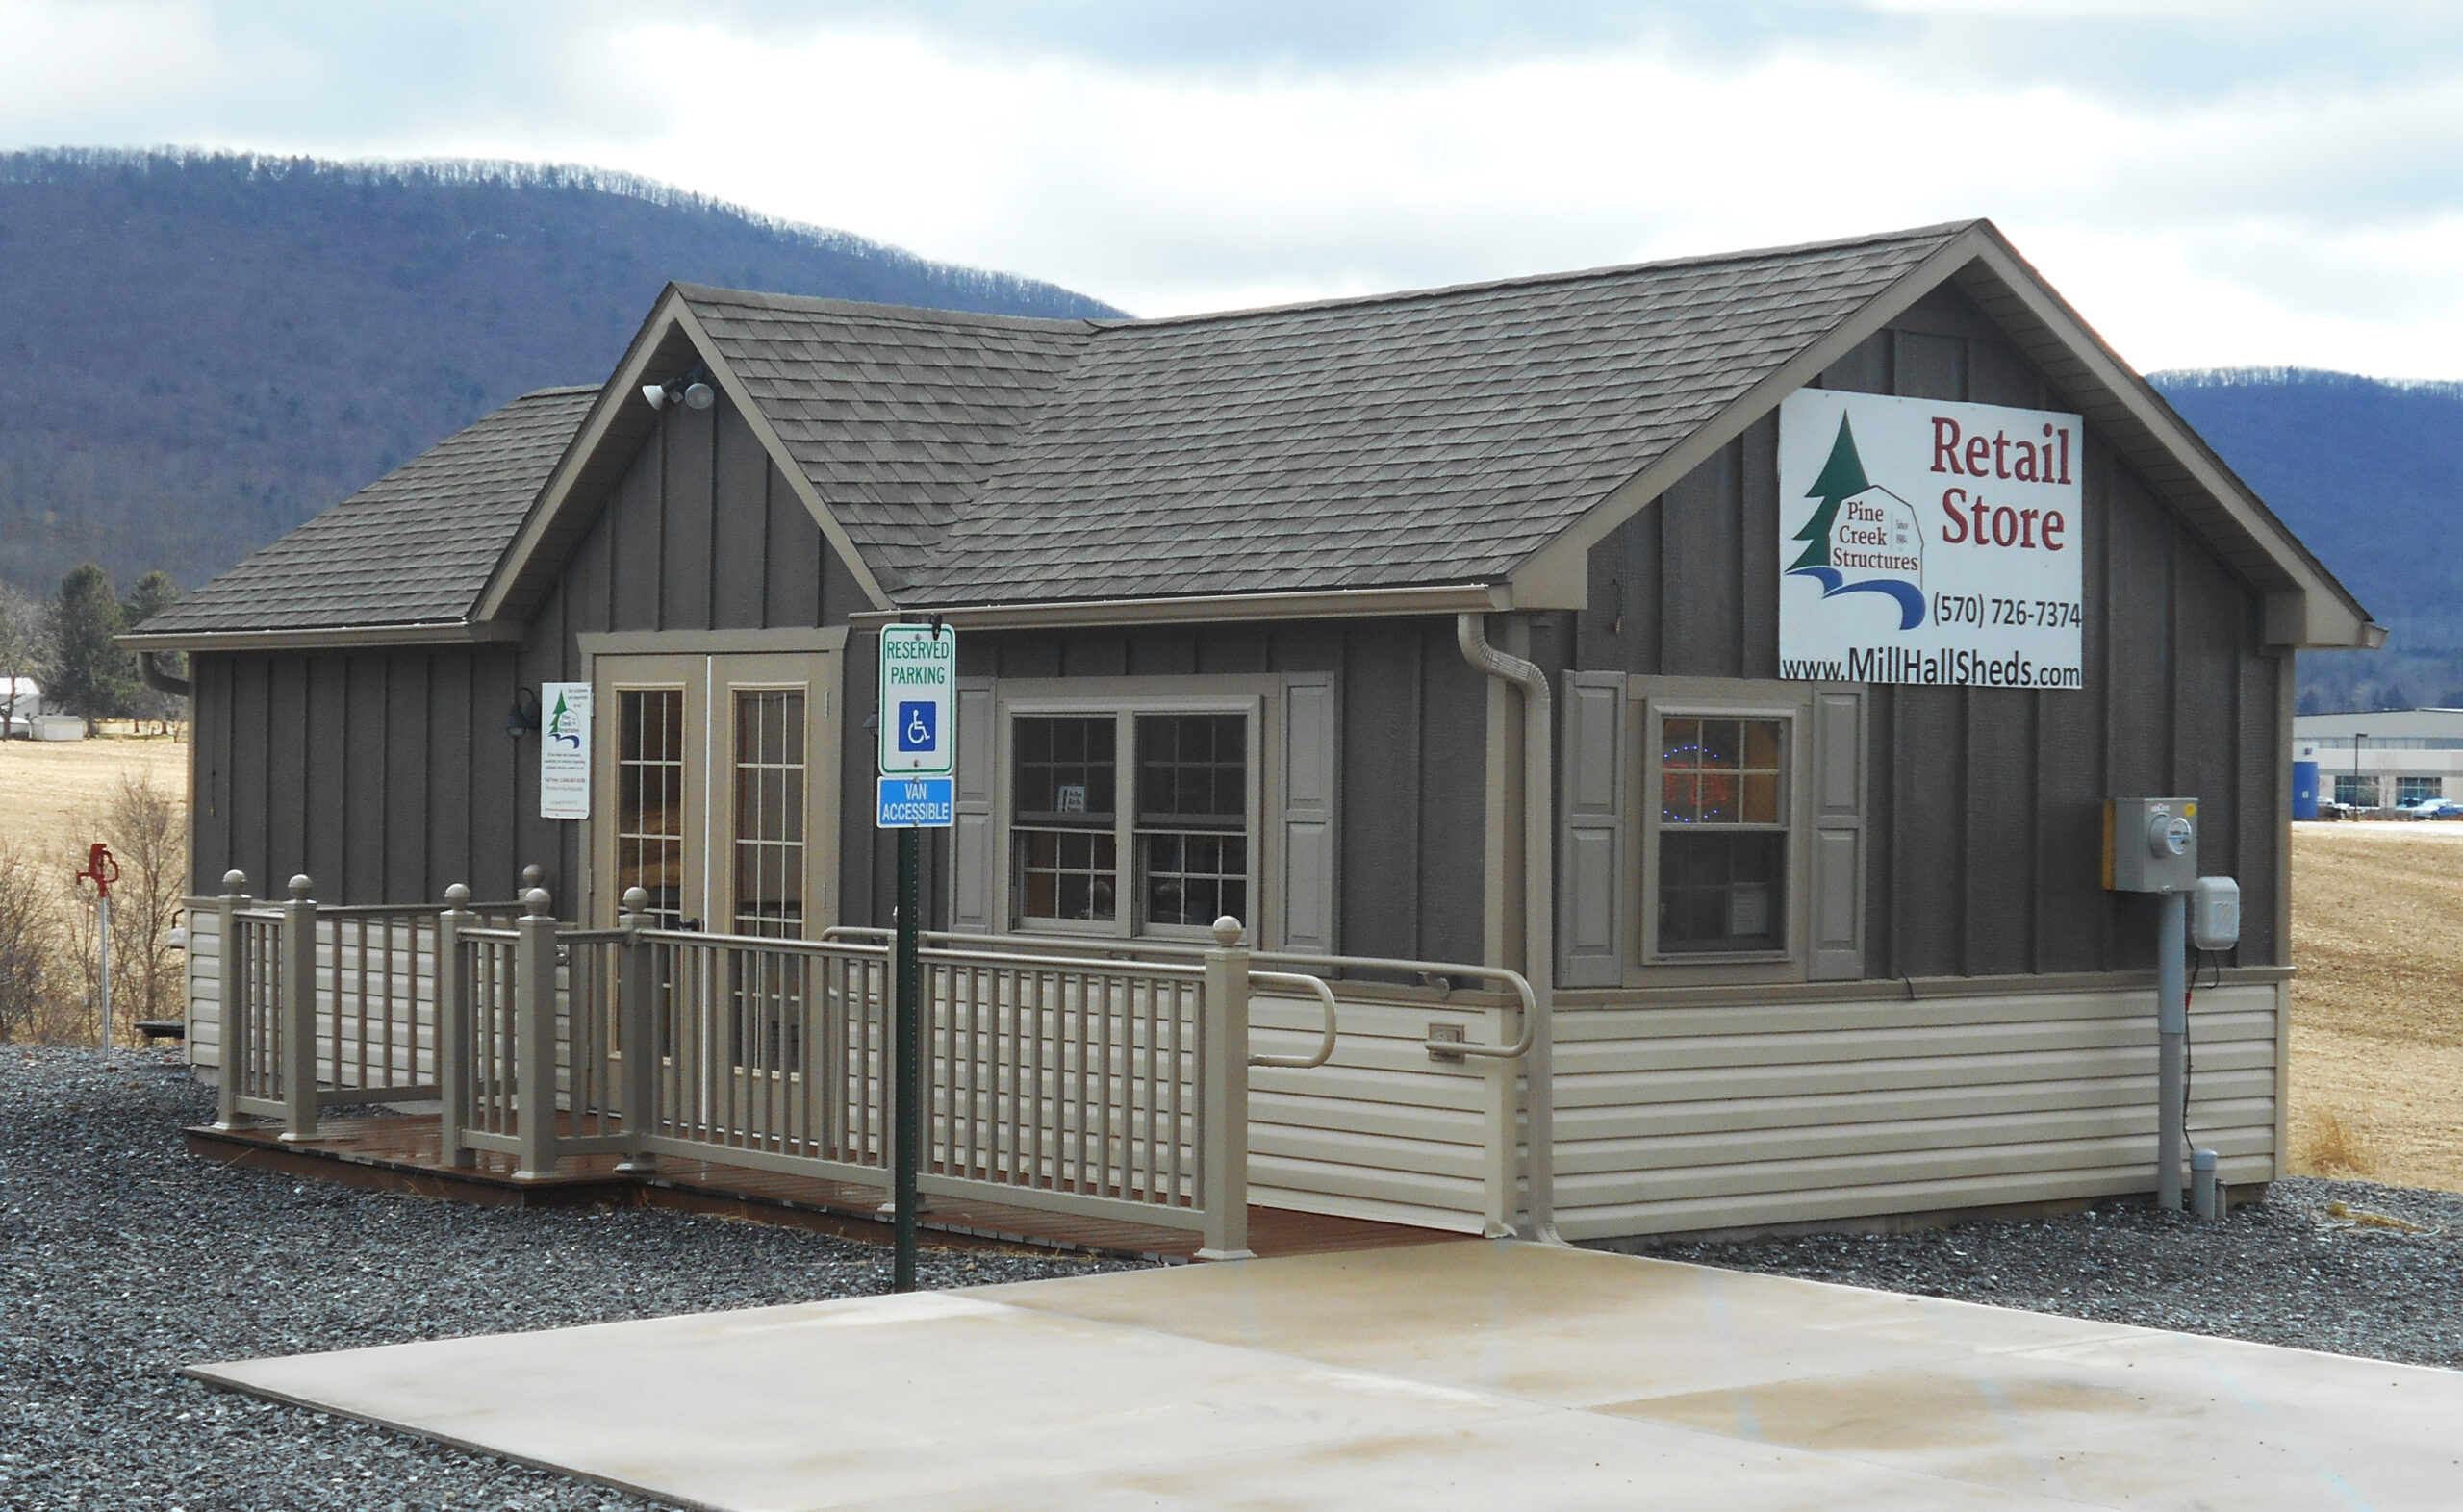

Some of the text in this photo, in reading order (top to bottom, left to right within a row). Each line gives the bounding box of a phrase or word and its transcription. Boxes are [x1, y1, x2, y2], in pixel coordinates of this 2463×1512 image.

[1930, 416, 2072, 485] Retail
[1847, 501, 1884, 522] Pine
[1942, 487, 2065, 551] Store
[1839, 525, 1887, 546] Creek
[1833, 547, 1918, 571] Structures
[1933, 592, 2081, 629] (570) 726-7374
[887, 641, 950, 659] RESERVED
[891, 667, 945, 685] PARKING
[1782, 646, 2081, 686] www.MillHallSheds.com
[905, 783, 927, 801] VAN
[882, 803, 949, 821] ACCESSIBLE
